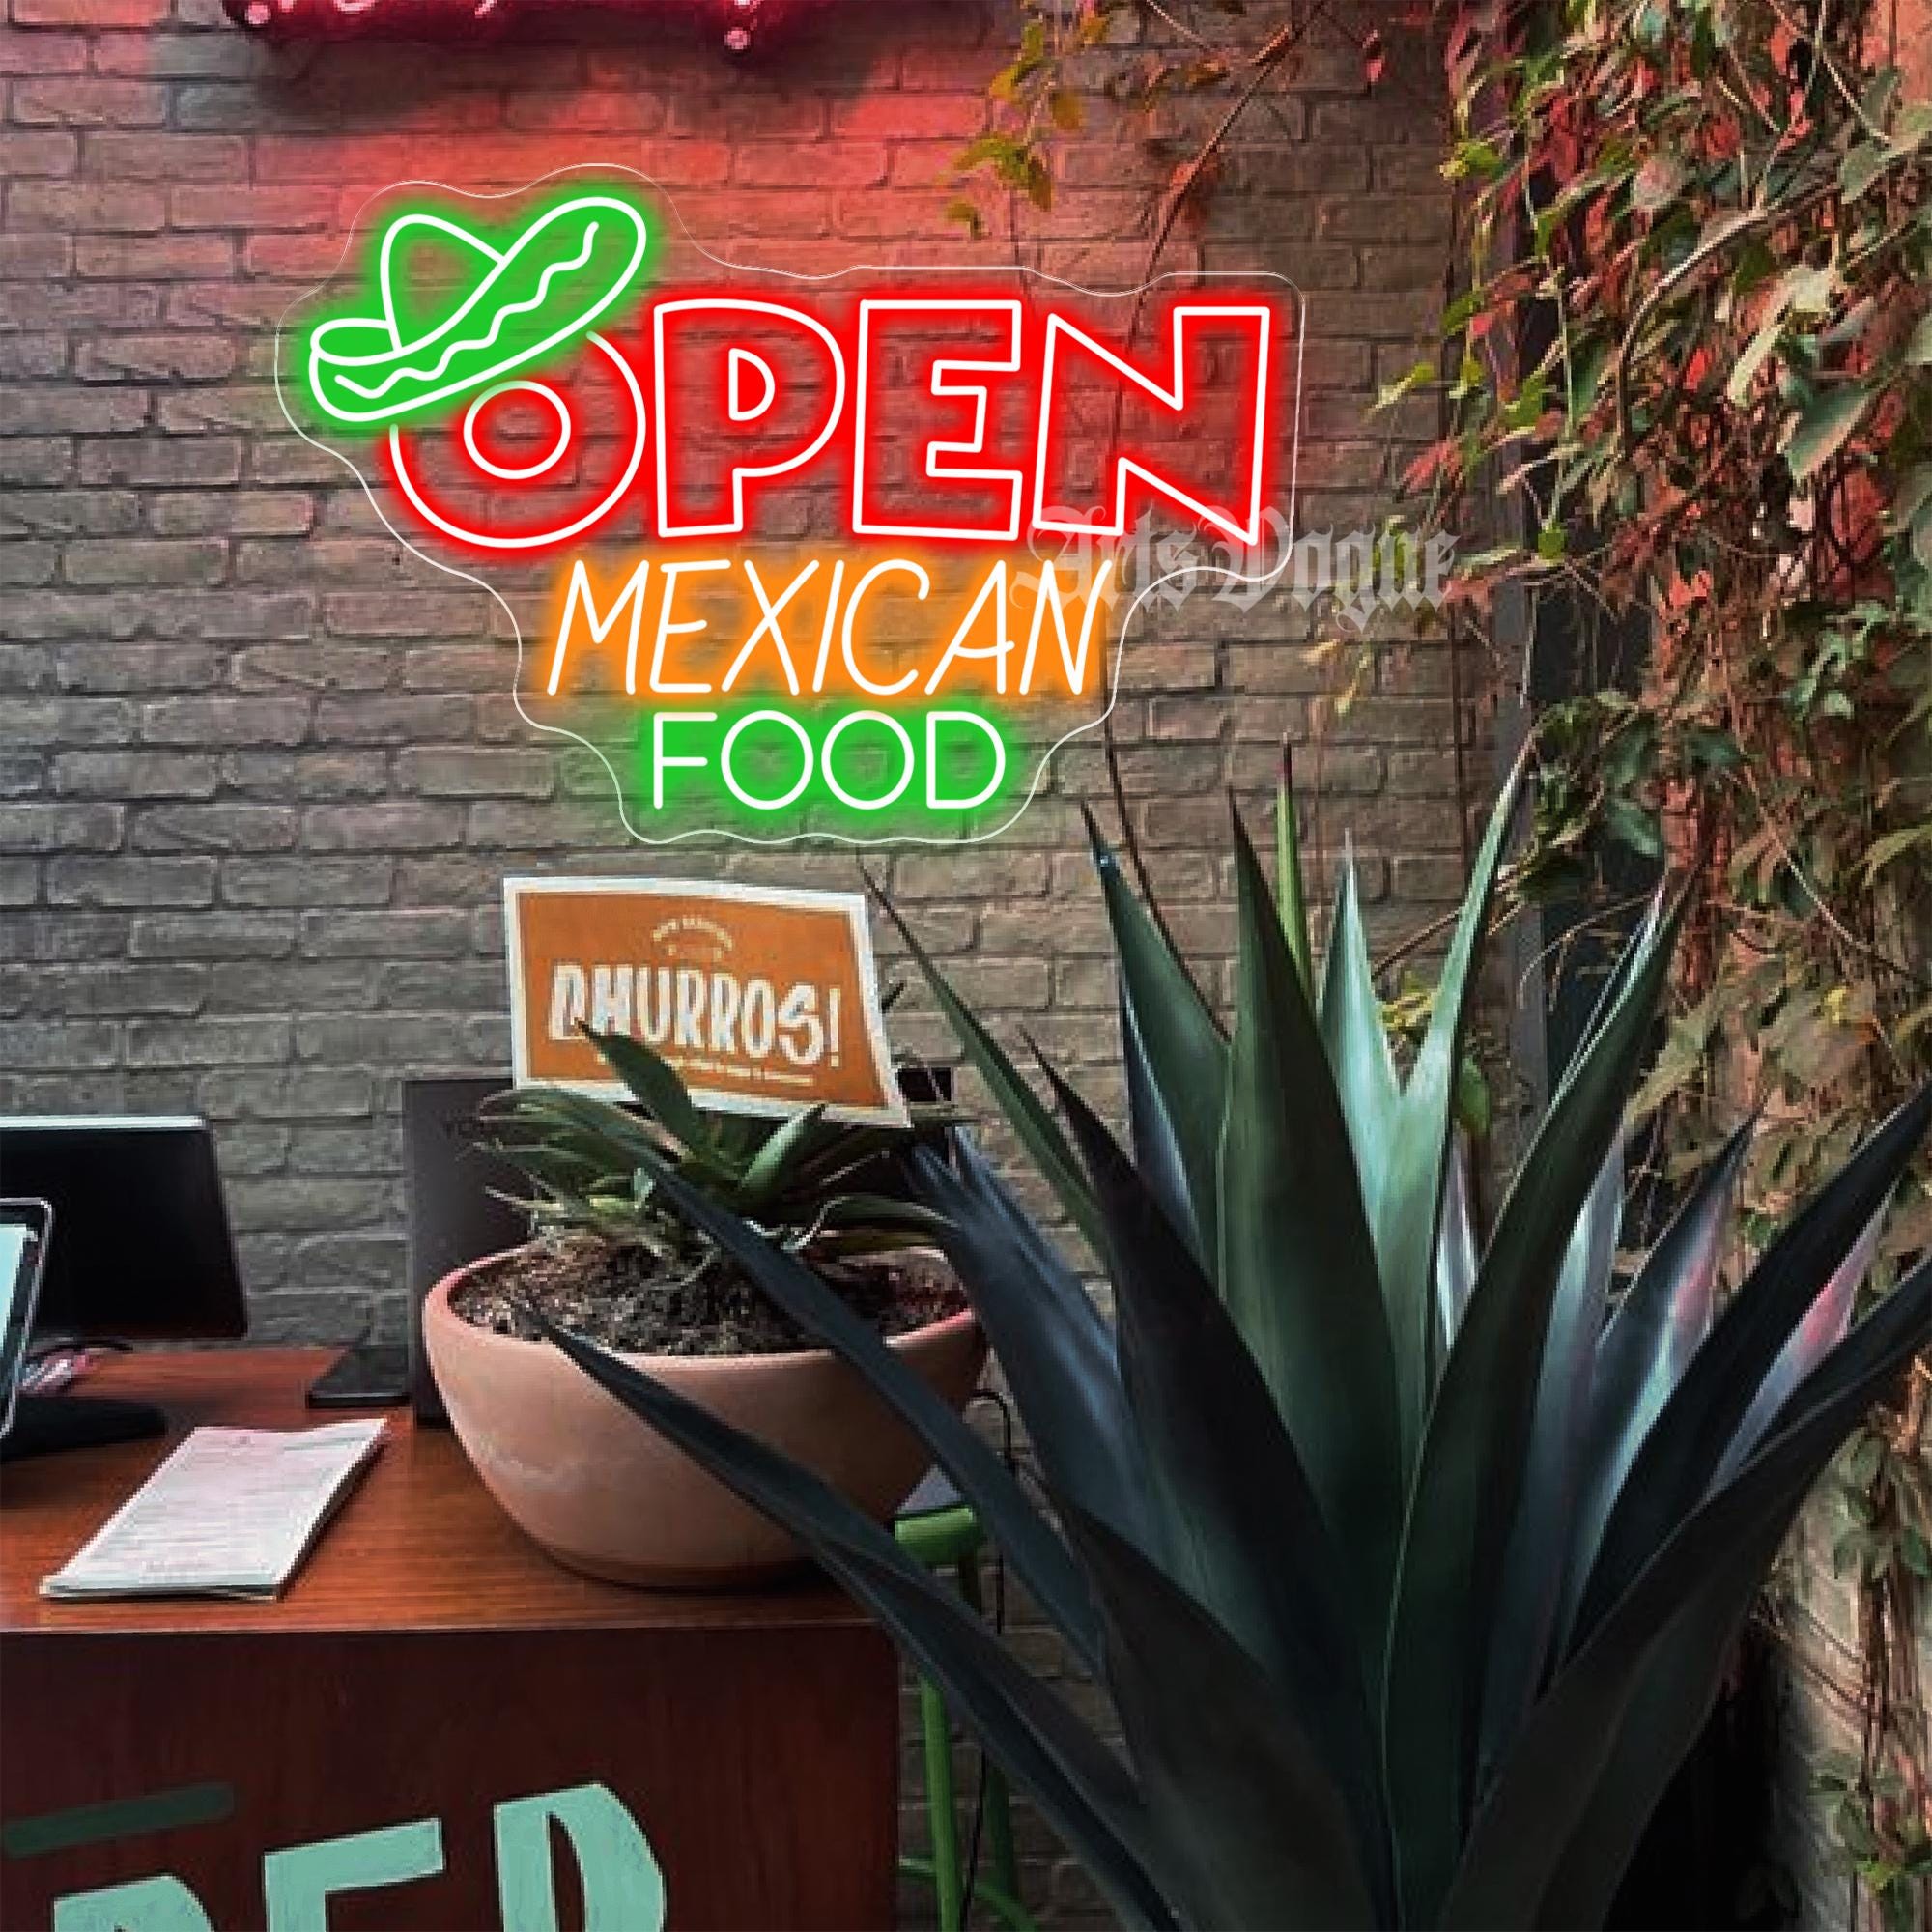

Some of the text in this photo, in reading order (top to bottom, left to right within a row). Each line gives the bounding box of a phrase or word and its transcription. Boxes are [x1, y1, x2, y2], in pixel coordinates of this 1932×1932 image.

[389, 298, 1271, 548] OPEN
[547, 558, 1113, 695] MEXICAN
[653, 710, 1006, 810] FOOD
